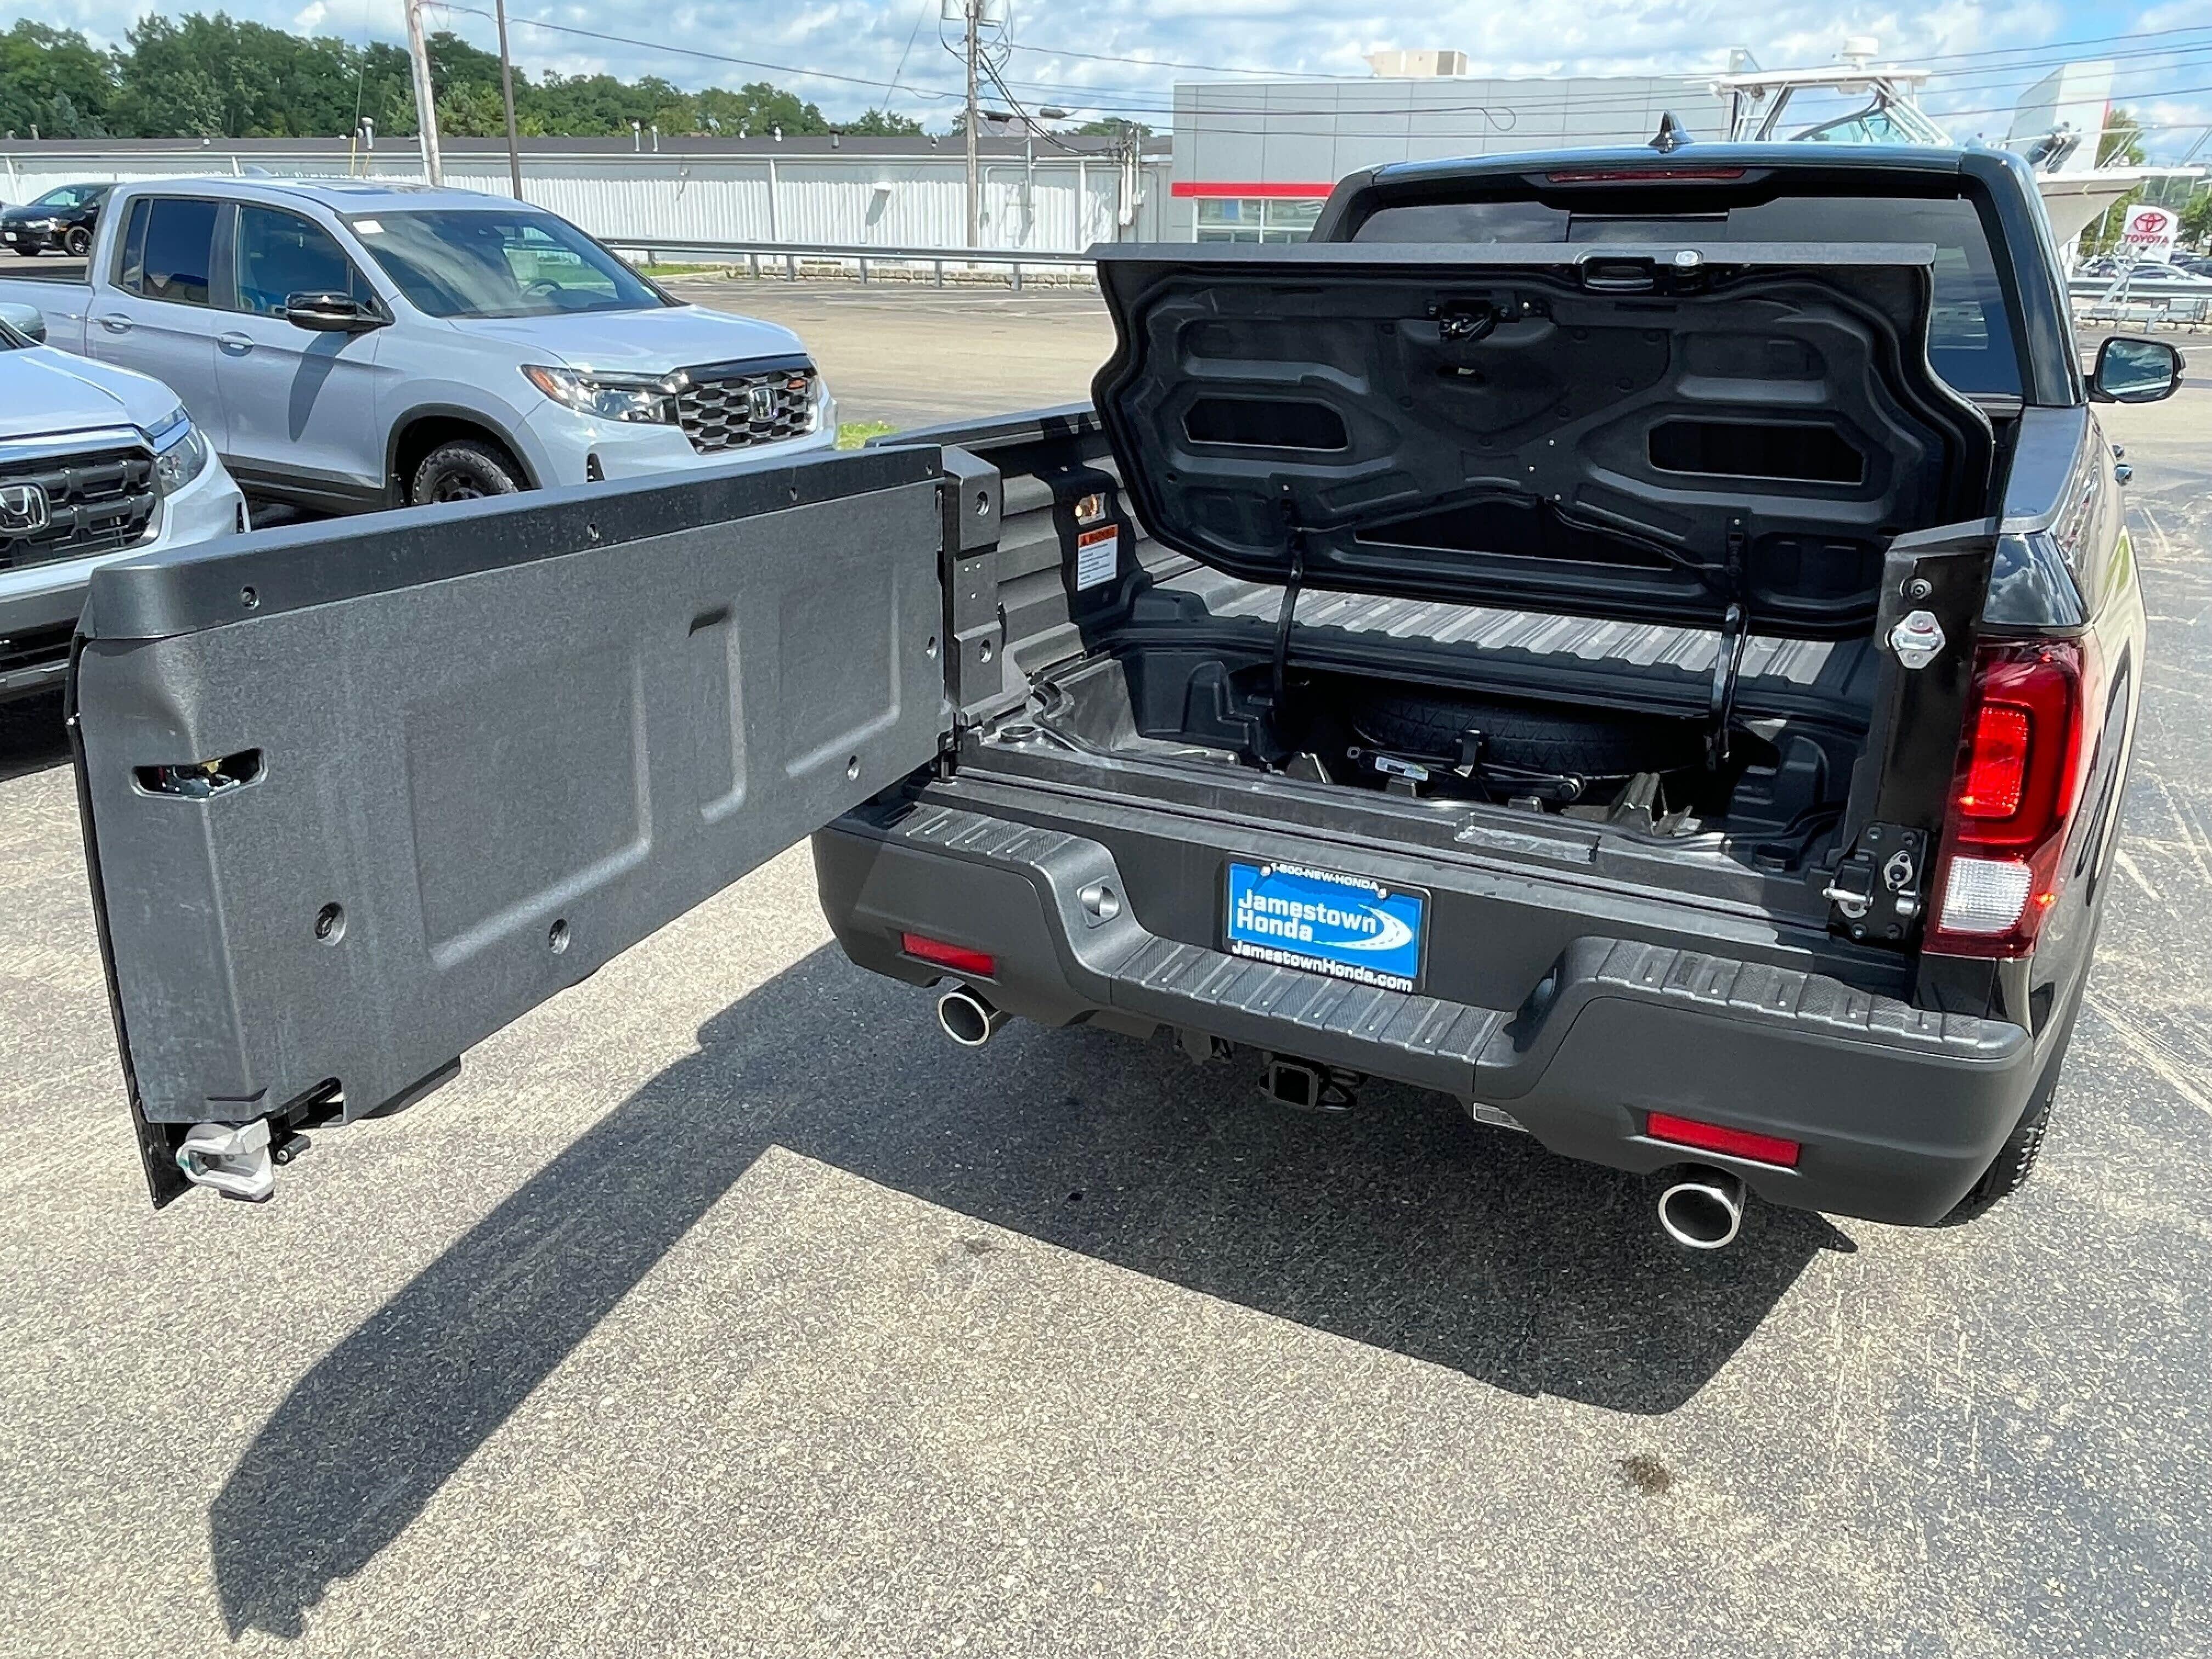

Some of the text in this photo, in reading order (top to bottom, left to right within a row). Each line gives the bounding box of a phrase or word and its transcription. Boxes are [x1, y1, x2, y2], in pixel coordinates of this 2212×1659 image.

[2125, 235, 2169, 245] TOYOTA
[1237, 907, 1313, 942] Honda
[1238, 889, 1377, 934] Jamestown
[1231, 940, 1413, 992] JamestownHonda.com
